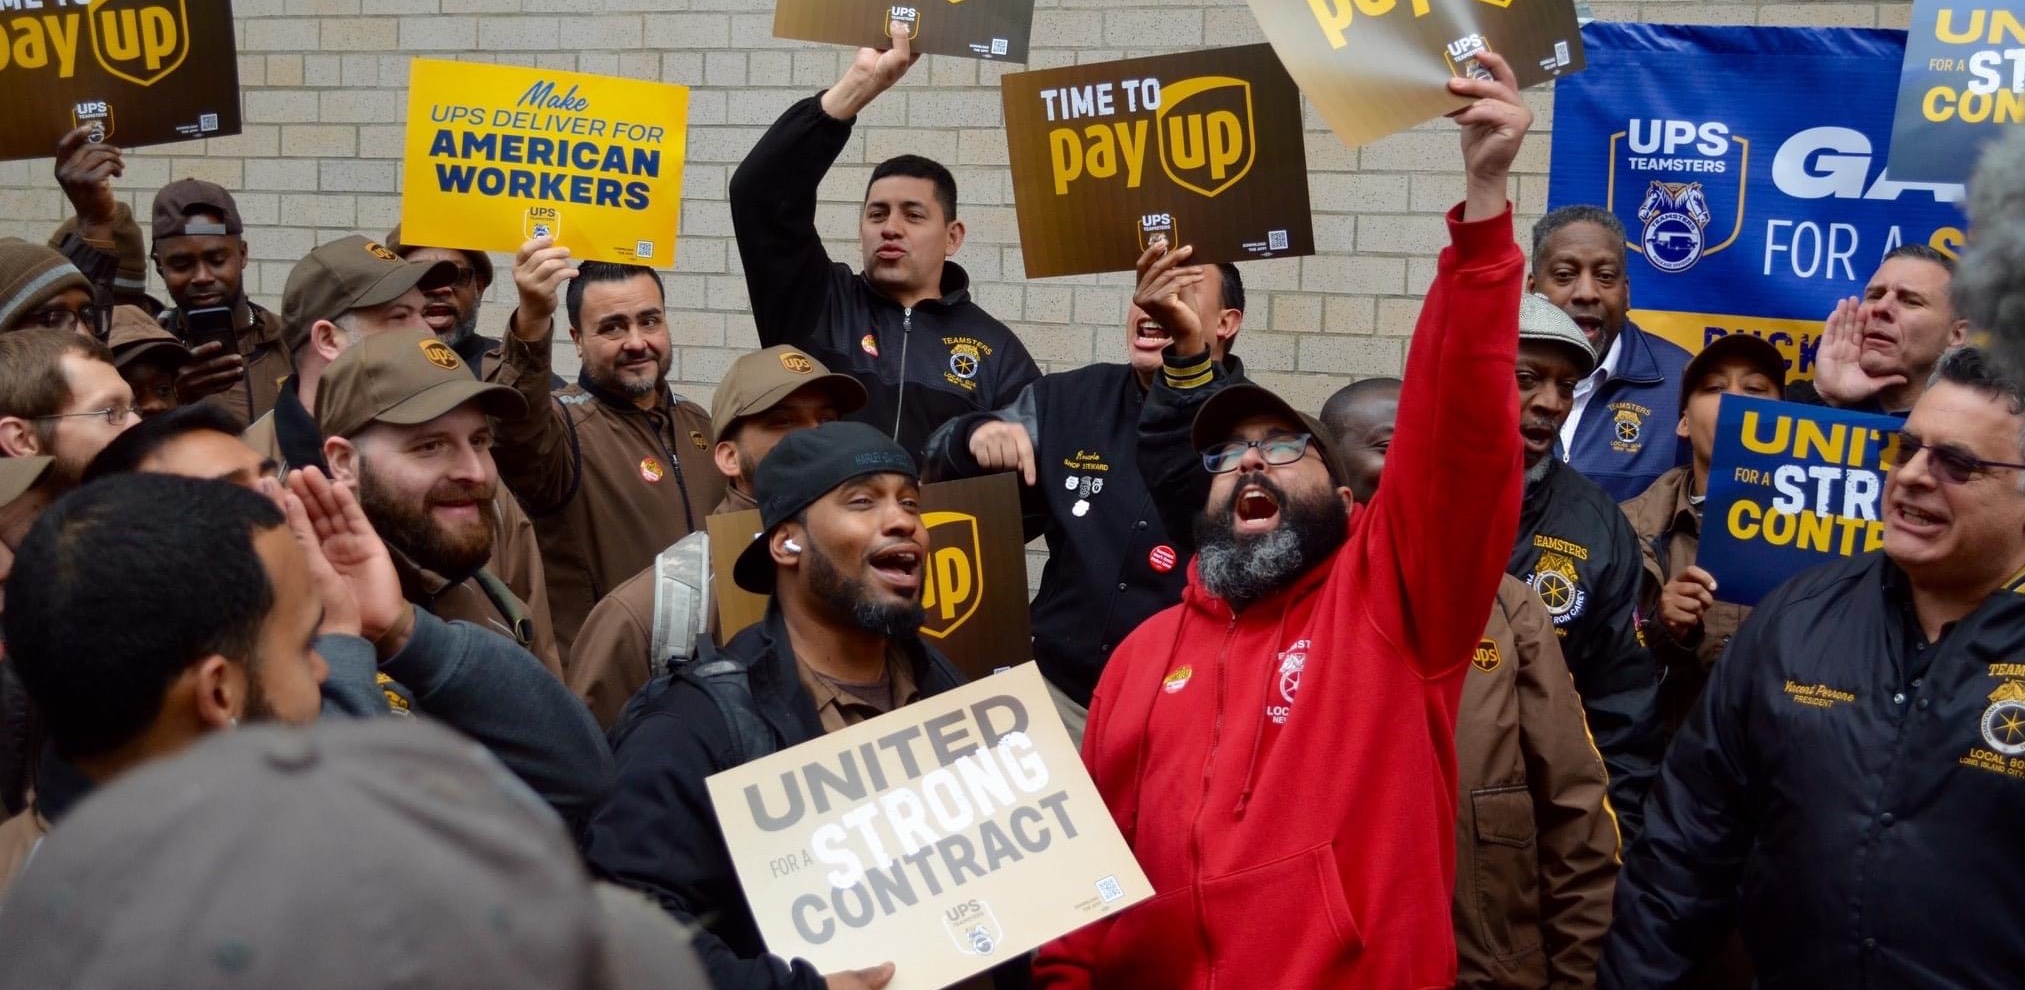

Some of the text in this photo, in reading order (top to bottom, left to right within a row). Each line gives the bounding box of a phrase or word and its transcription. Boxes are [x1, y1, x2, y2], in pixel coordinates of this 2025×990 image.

[892, 6, 916, 17] UPS
[0, 6, 177, 78] ay up
[1447, 34, 1482, 56] UPS
[1928, 58, 1952, 71] FOR
[1956, 59, 1964, 71] A
[517, 80, 589, 112] Make
[1040, 78, 1161, 121] TIME TO
[77, 101, 108, 115] UPS
[431, 105, 665, 143] UPS DELIVER FOR
[1628, 118, 1729, 157] UPS
[429, 129, 661, 178] AMERICAN
[1050, 110, 1242, 195] pay up
[1628, 157, 1726, 174] TEAMSTERS
[435, 163, 651, 210] WORKERS
[530, 207, 556, 218] UPS
[1142, 214, 1170, 226] UPS
[1763, 219, 1858, 281] FOR
[426, 348, 454, 365] ups
[942, 337, 993, 356] TEAMSTERS
[784, 358, 810, 370] ups
[1607, 402, 1651, 416] TEAMSTERS
[1734, 467, 1759, 484] FOR
[1761, 471, 1771, 486] A
[1553, 613, 1571, 624] RON
[1570, 590, 1586, 616] CAREY
[1793, 695, 1834, 708] PRESIDENT
[743, 695, 1030, 832] UNITED
[1970, 748, 2025, 769] LOCAL 80
[770, 732, 1049, 889] FOR A STRONG
[791, 790, 1079, 946] CONTRACT
[946, 899, 981, 921] UPS
